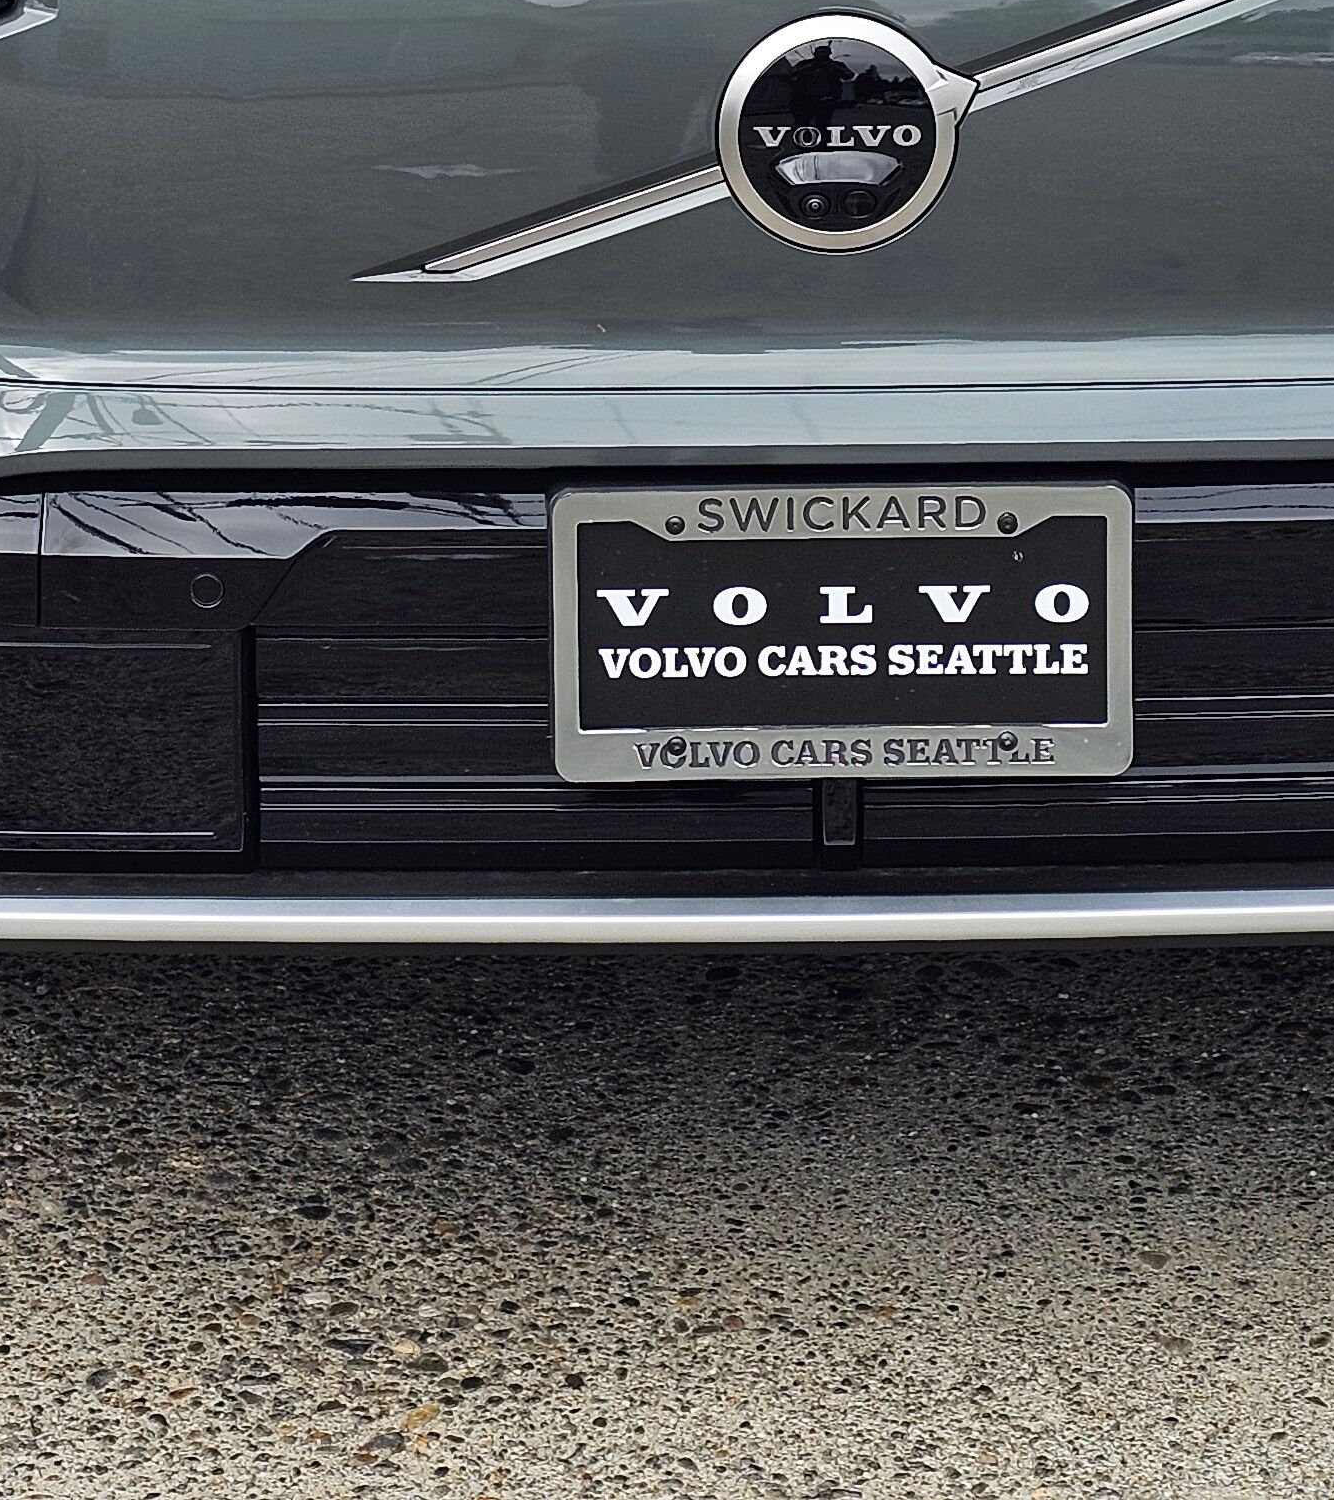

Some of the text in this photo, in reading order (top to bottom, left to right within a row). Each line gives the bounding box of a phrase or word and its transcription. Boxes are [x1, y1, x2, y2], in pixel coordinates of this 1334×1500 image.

[753, 124, 922, 148] VOLVO
[698, 495, 987, 534] SWICKARD
[596, 583, 1090, 627] VOLVO
[598, 643, 1089, 679] VOLVO CARS SEATTLE
[633, 739, 761, 770] VOLVO
[771, 738, 873, 768] CARS
